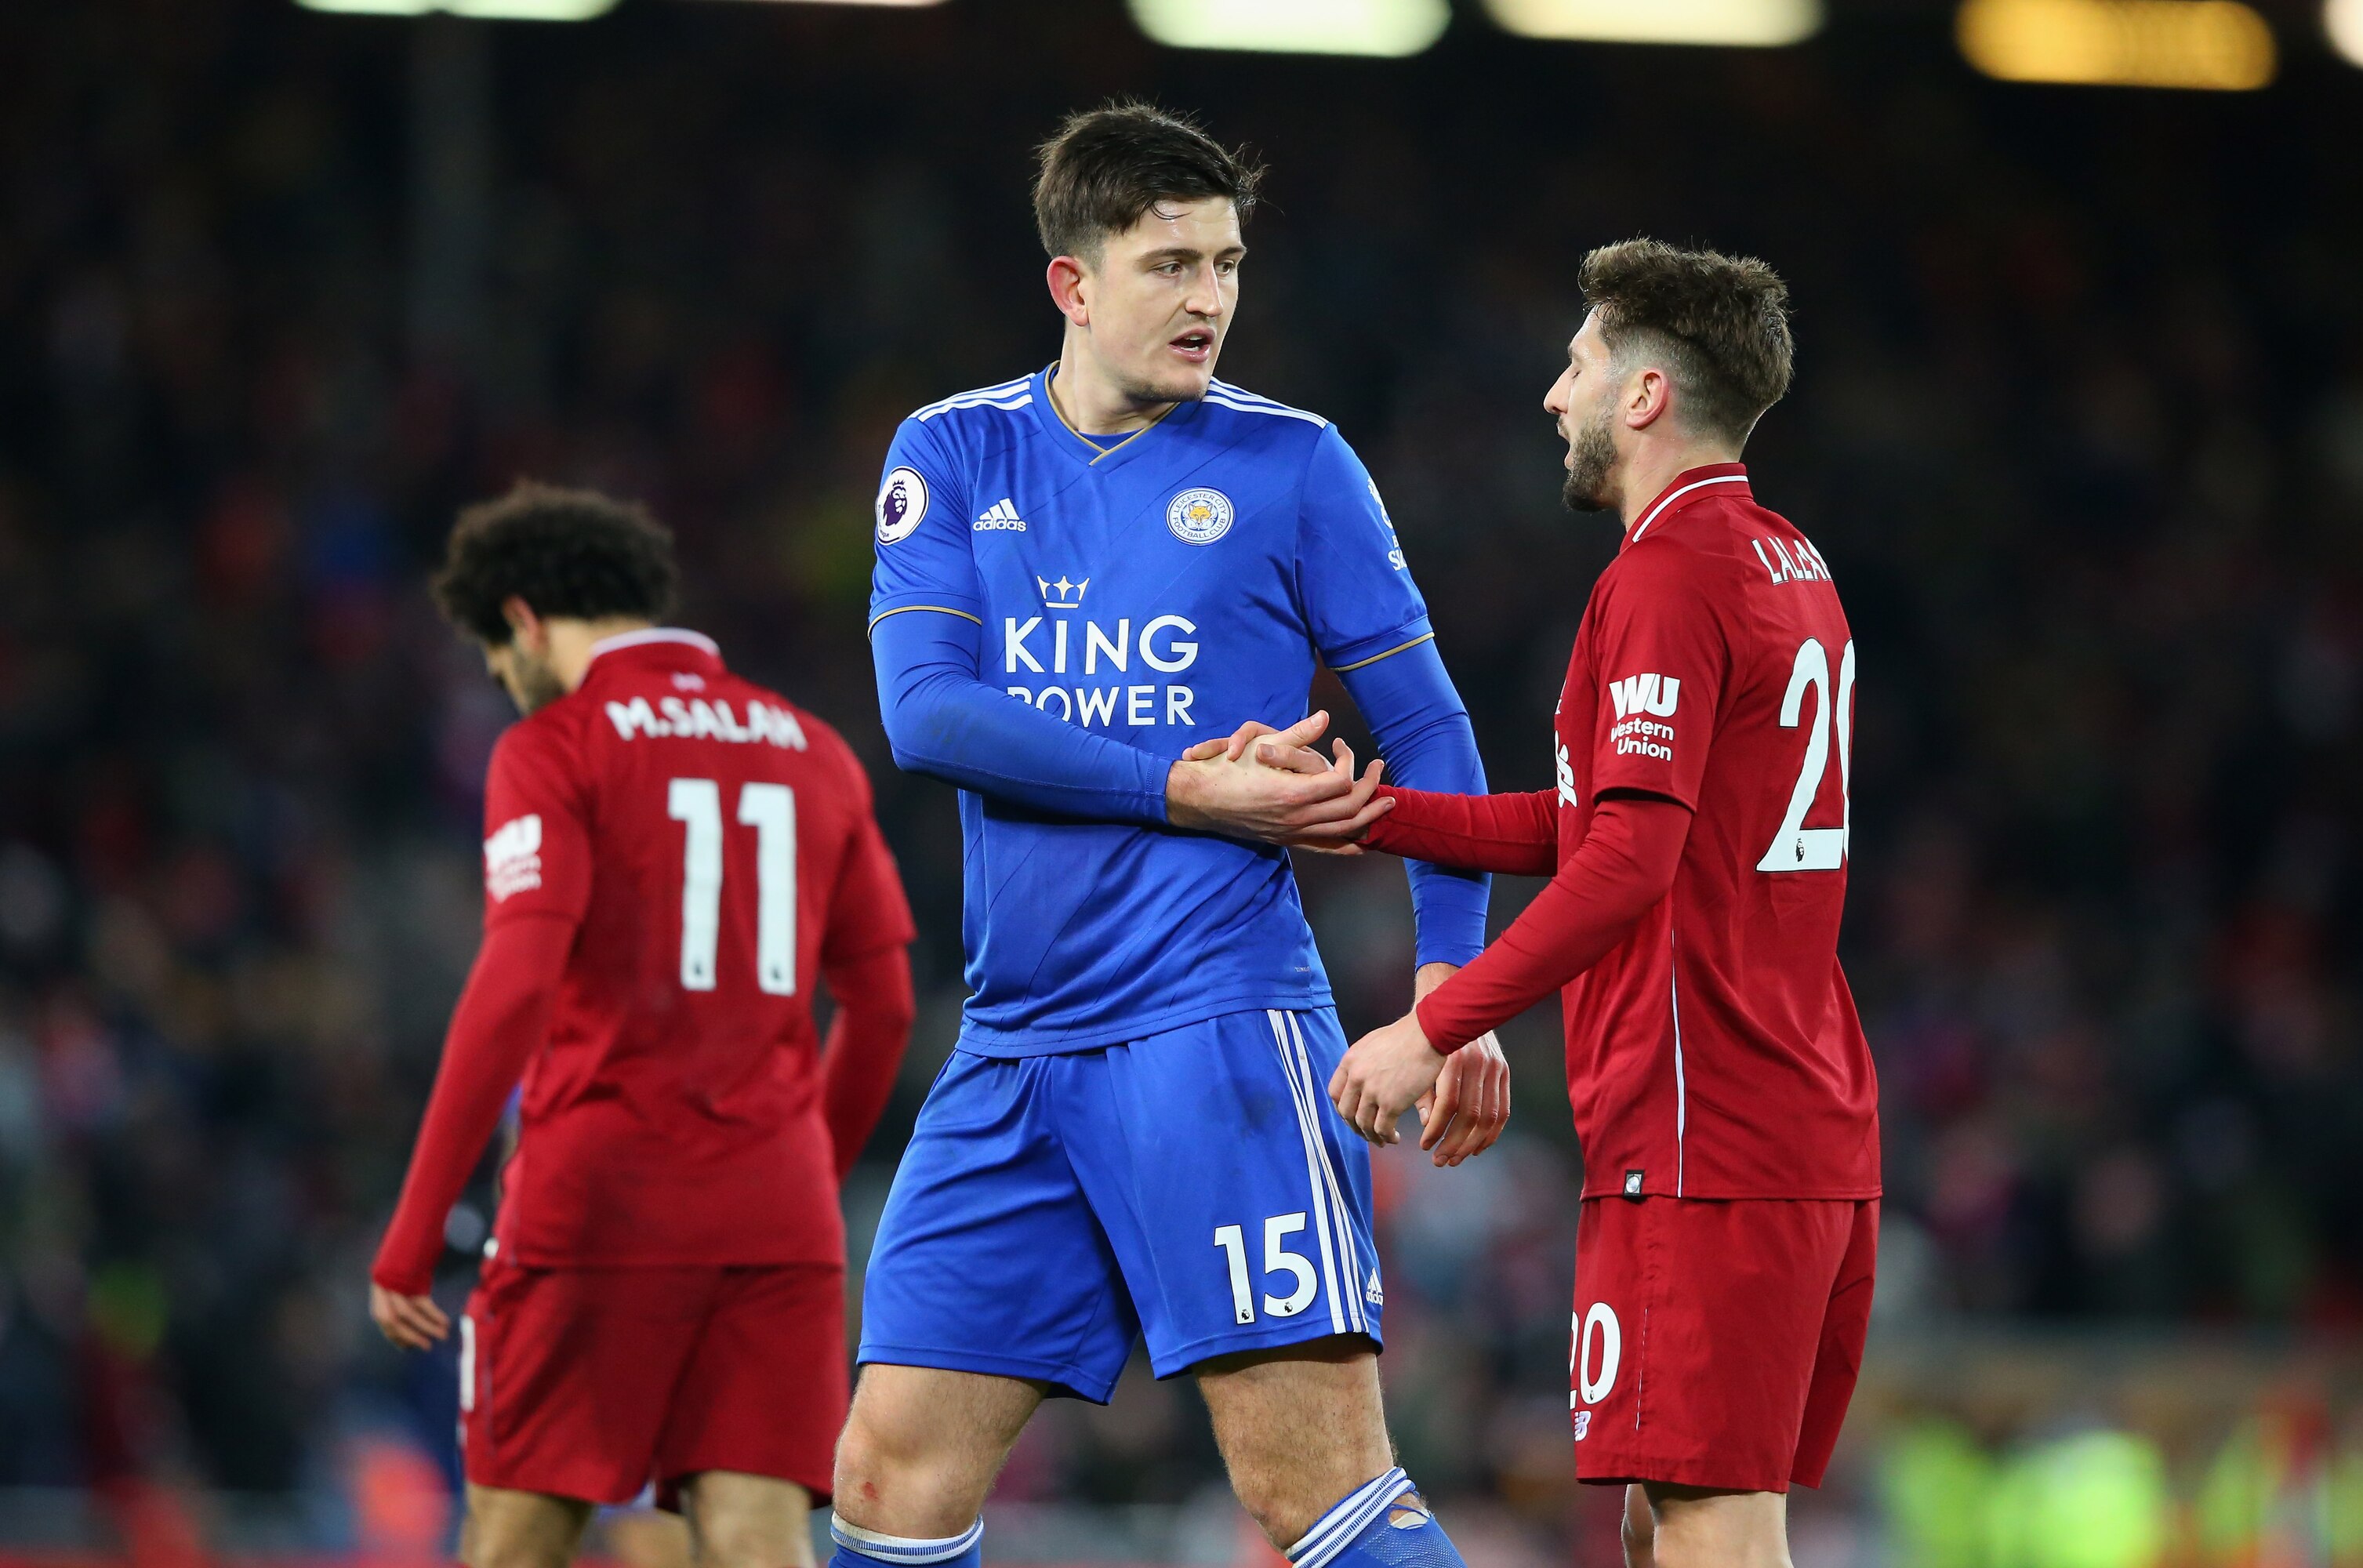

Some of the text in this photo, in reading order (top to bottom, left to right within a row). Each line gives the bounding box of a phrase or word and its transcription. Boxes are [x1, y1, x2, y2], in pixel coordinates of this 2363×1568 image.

[1174, 492, 1227, 514] LEICESTER CITY
[973, 517, 1026, 532] adidas
[1173, 517, 1226, 539] FOOTBALL CLUB
[1004, 615, 1200, 675] KING
[1609, 673, 1680, 721] WU
[604, 695, 808, 752] M.SALAH
[1610, 717, 1674, 743] Western
[1617, 735, 1672, 761] Union
[666, 778, 796, 996] 11
[1214, 1211, 1318, 1325] 15
